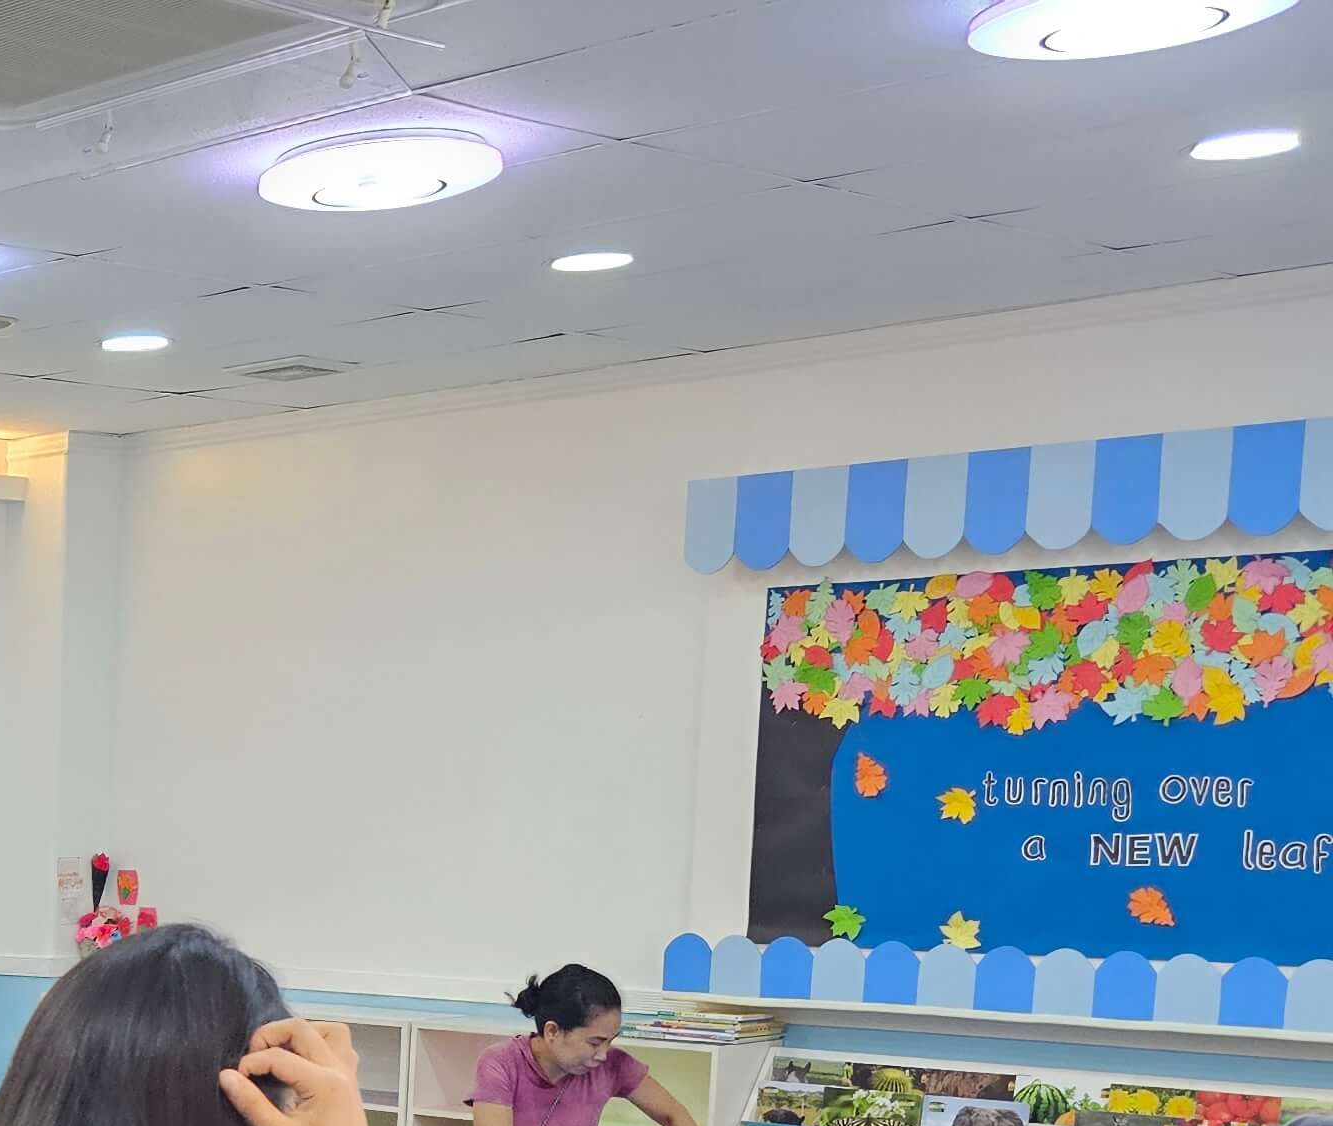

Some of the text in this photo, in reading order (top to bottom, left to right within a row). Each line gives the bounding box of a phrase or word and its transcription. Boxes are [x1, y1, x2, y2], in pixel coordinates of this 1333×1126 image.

[983, 771, 1254, 822] turning over
[1021, 829, 1333, 874] a NEW leaf
